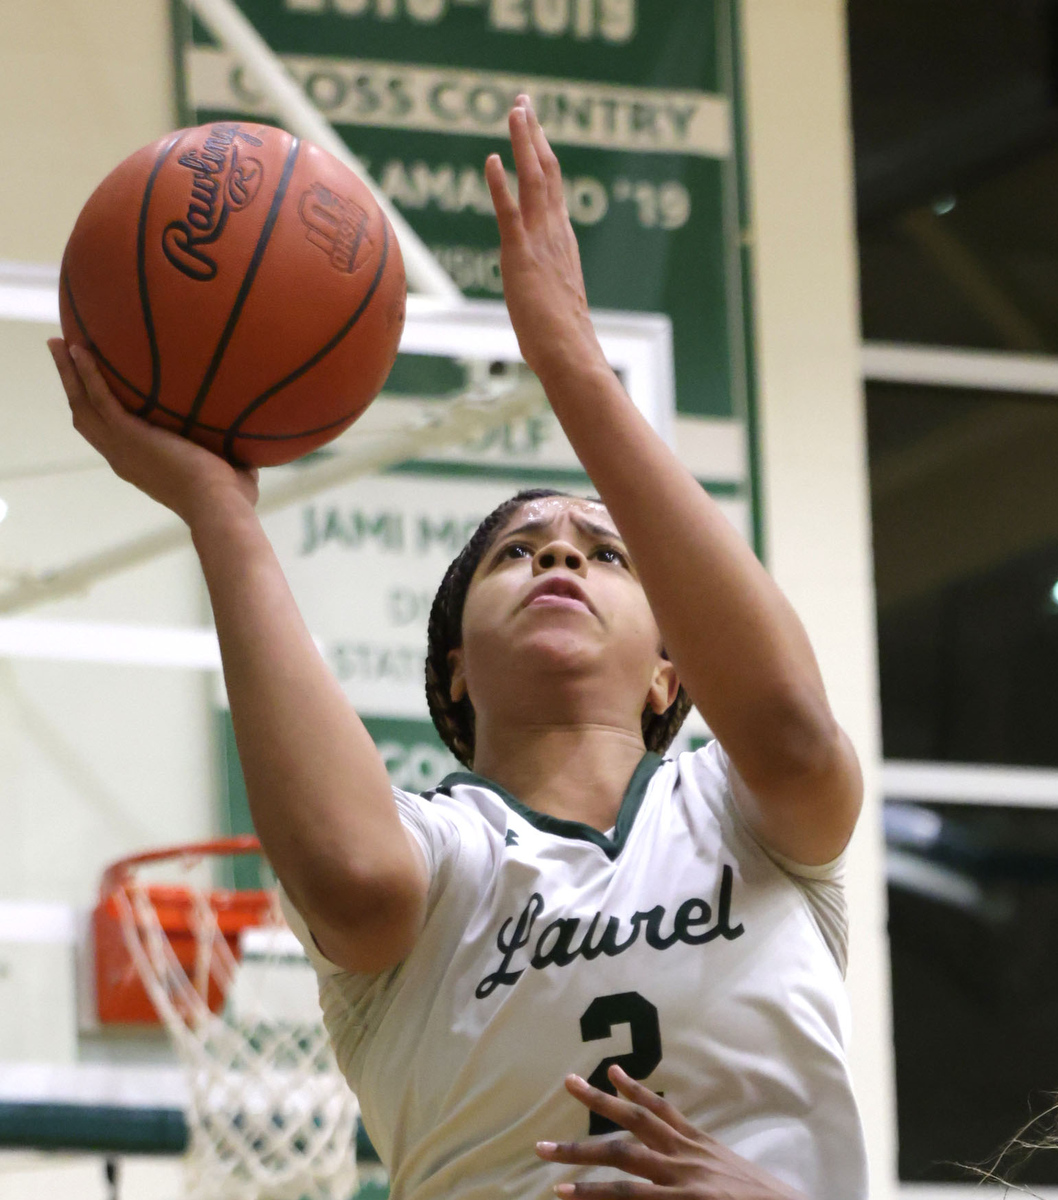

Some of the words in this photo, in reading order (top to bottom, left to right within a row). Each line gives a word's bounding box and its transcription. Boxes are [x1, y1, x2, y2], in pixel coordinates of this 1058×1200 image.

[229, 62, 413, 118] COSS
[297, 503, 404, 558] JAMI
[475, 864, 745, 1000] Laurel
[579, 990, 664, 1136] 2
